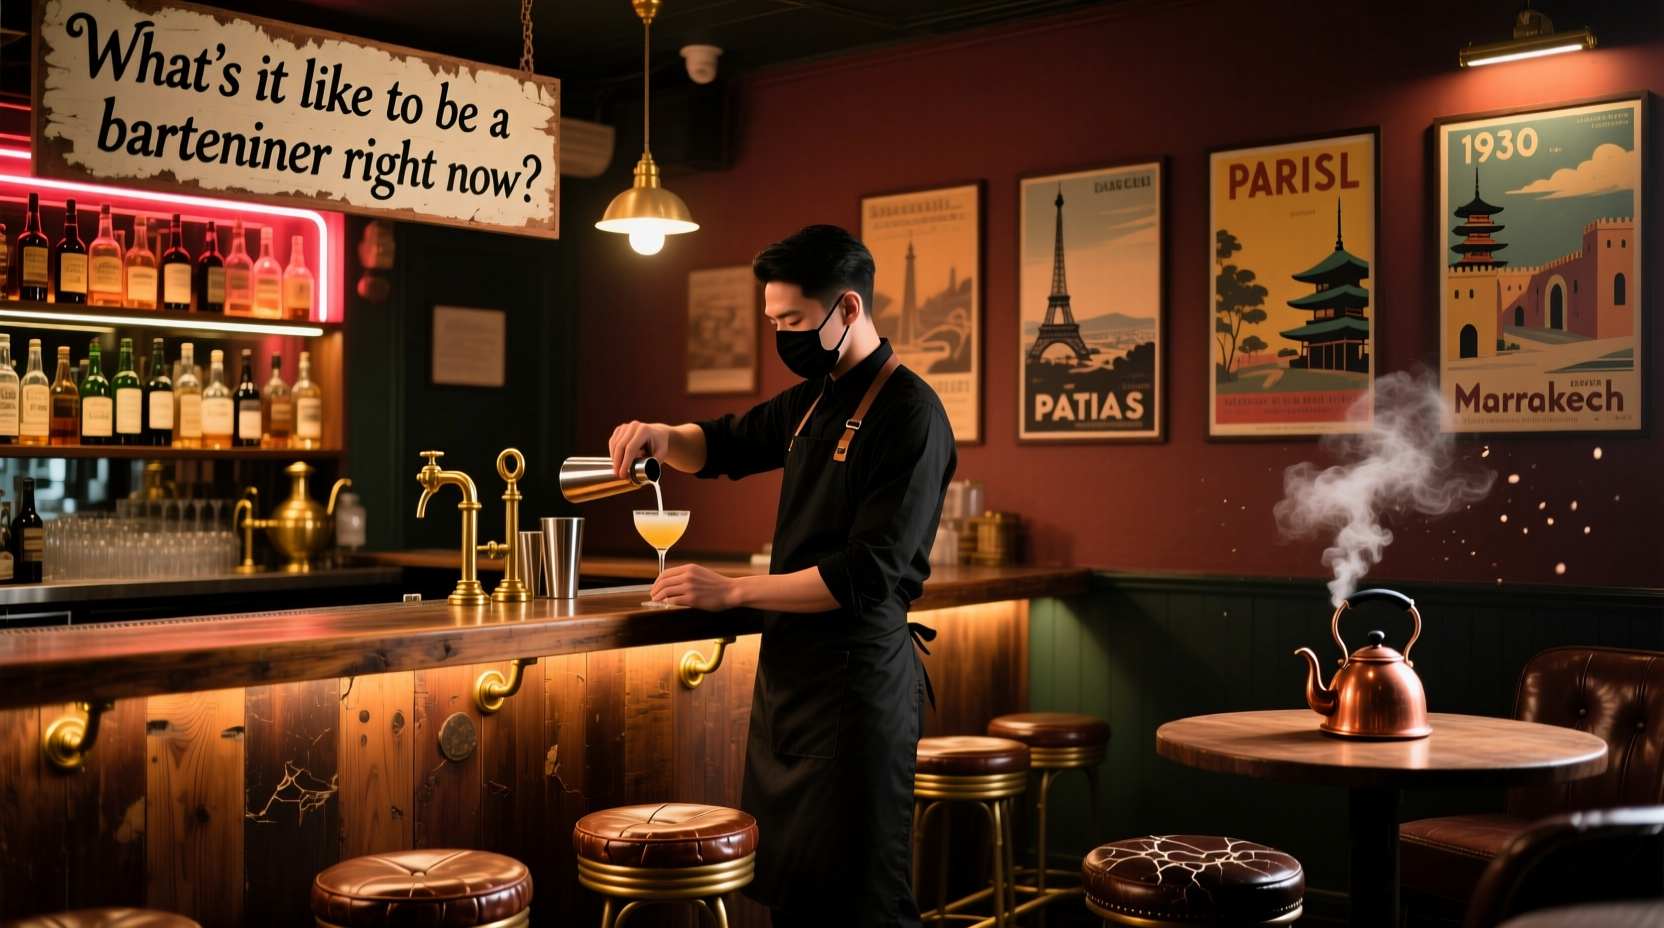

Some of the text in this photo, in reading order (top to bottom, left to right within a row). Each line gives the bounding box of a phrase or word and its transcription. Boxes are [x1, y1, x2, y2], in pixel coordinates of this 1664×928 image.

[65, 11, 510, 139] What's it like to be a
[97, 95, 542, 203] barteniner right now?
[1461, 126, 1539, 165] 1930
[1229, 151, 1361, 200] PARISL
[1034, 391, 1145, 422] PATIAS
[1454, 378, 1625, 414] Marrakech
